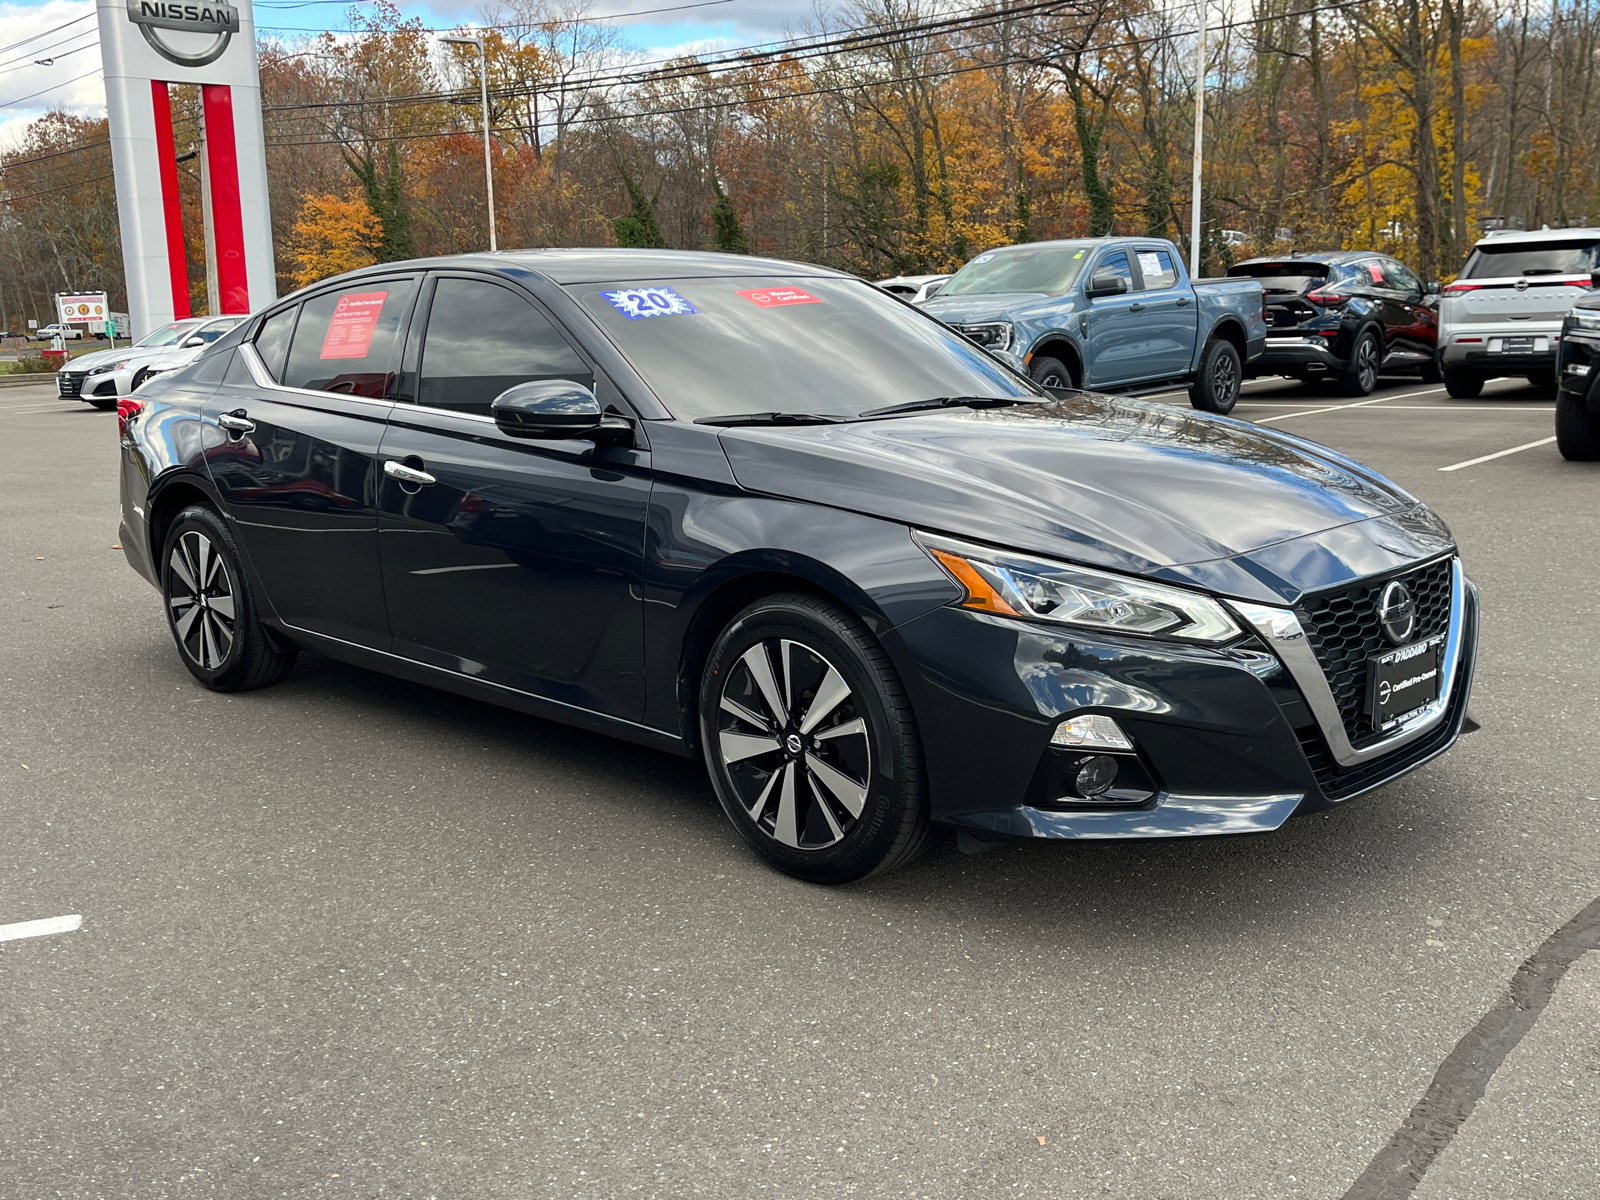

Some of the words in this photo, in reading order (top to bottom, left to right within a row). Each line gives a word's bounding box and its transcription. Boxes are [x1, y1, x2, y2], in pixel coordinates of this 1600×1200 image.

[141, 1, 231, 25] NISSAN
[627, 292, 671, 311] 20
[1469, 293, 1577, 302] PATHFINDER
[1386, 603, 1412, 620] NISSAN
[1395, 642, 1427, 663] D'ADDARIO
[1392, 677, 1413, 692] Certified
[1412, 667, 1437, 685] Pre-Owned
